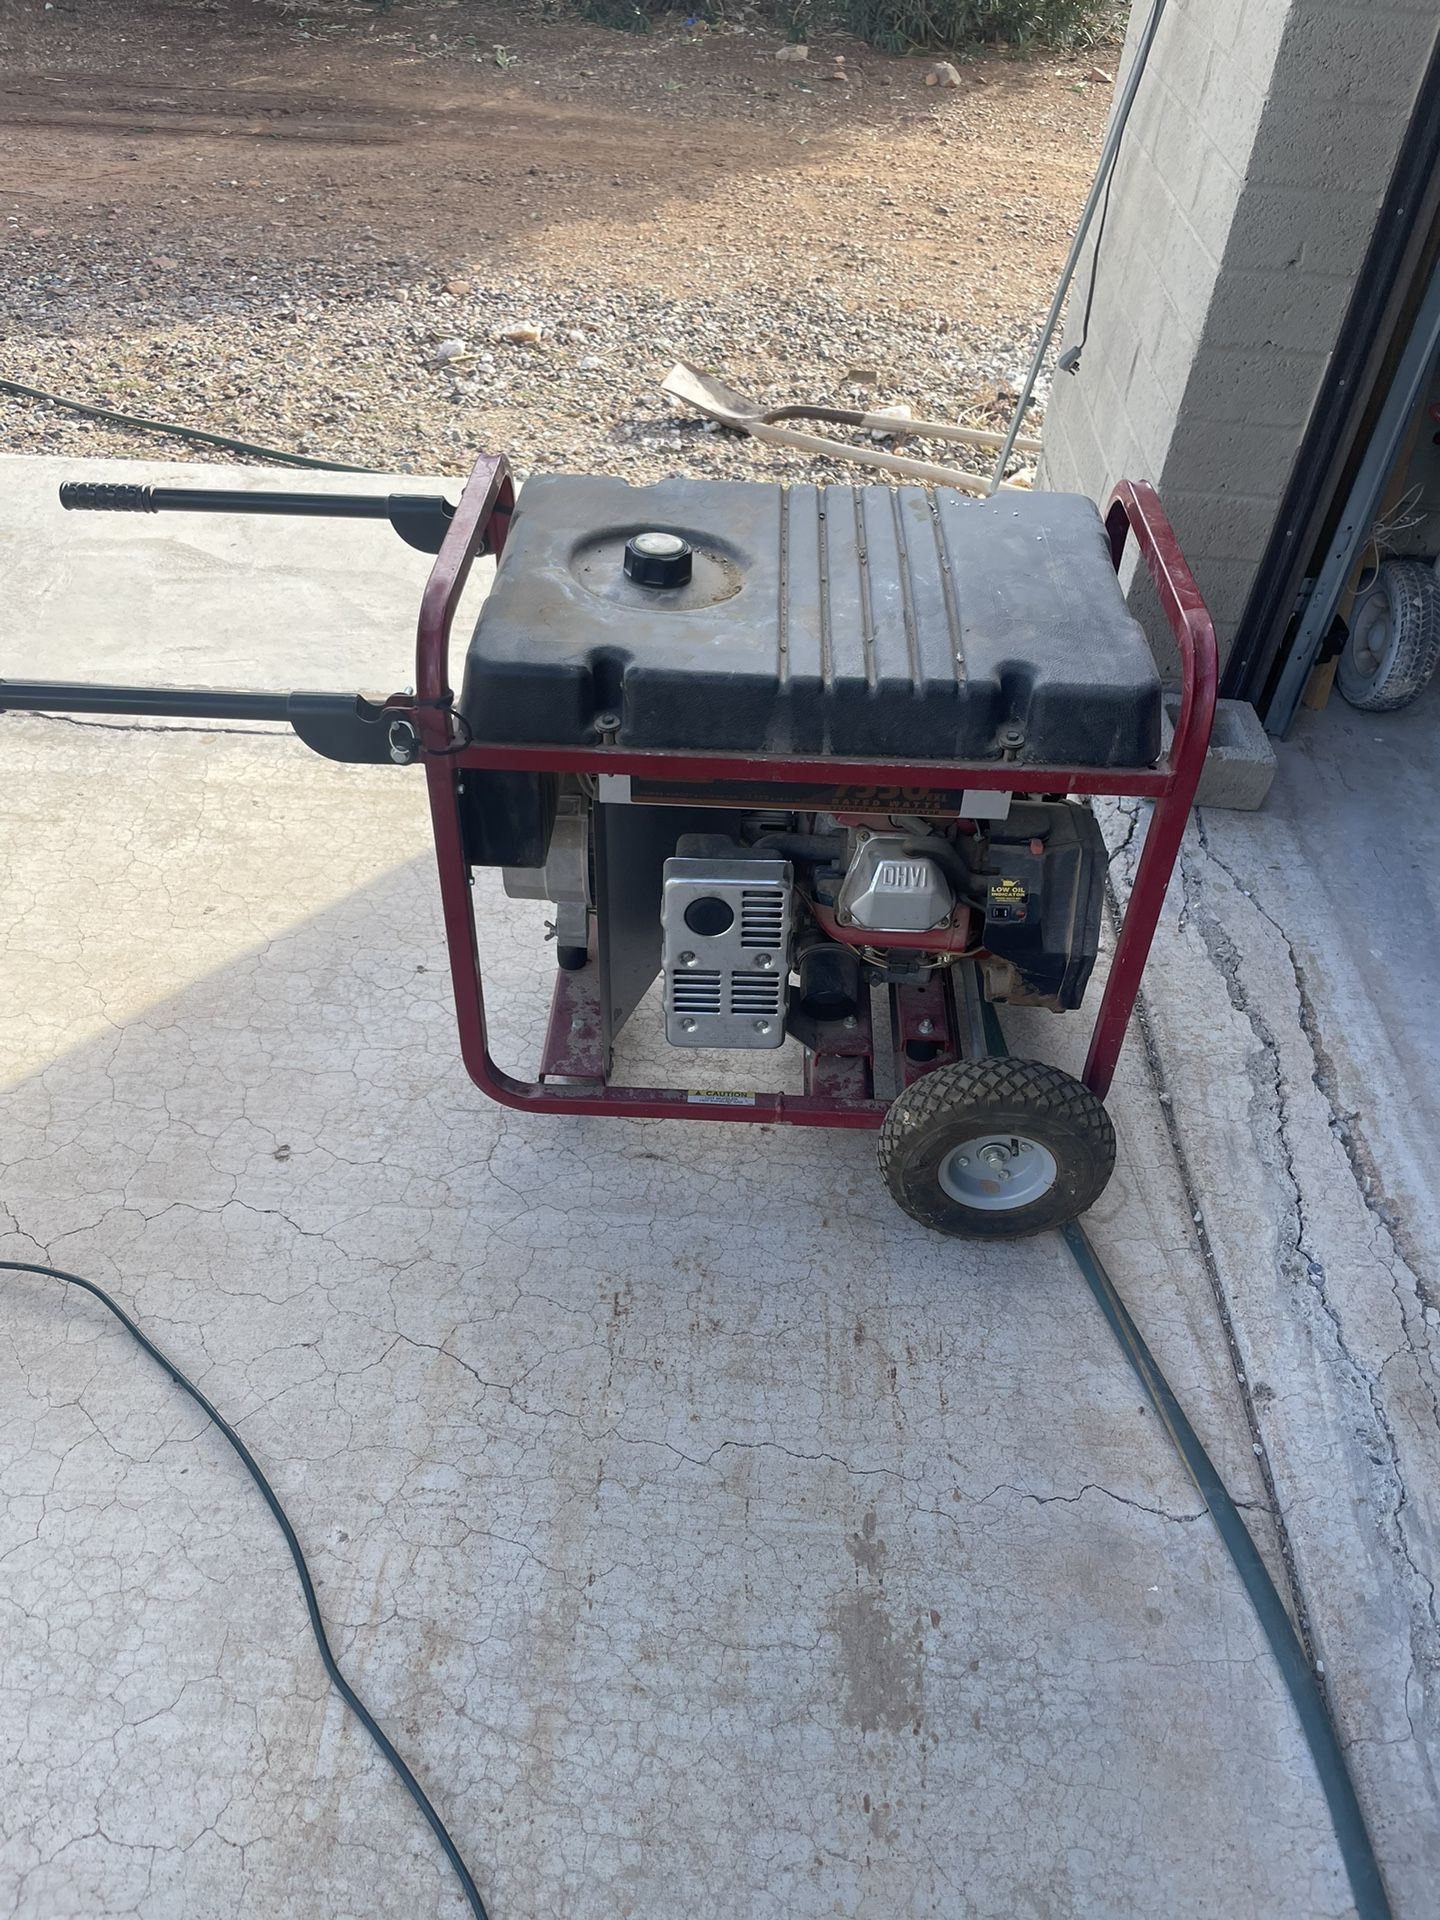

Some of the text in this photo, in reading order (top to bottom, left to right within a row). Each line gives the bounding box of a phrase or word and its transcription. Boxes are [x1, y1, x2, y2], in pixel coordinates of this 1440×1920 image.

[832, 799, 941, 809] RATED WATTS
[706, 1090, 748, 1098] CAUTION
